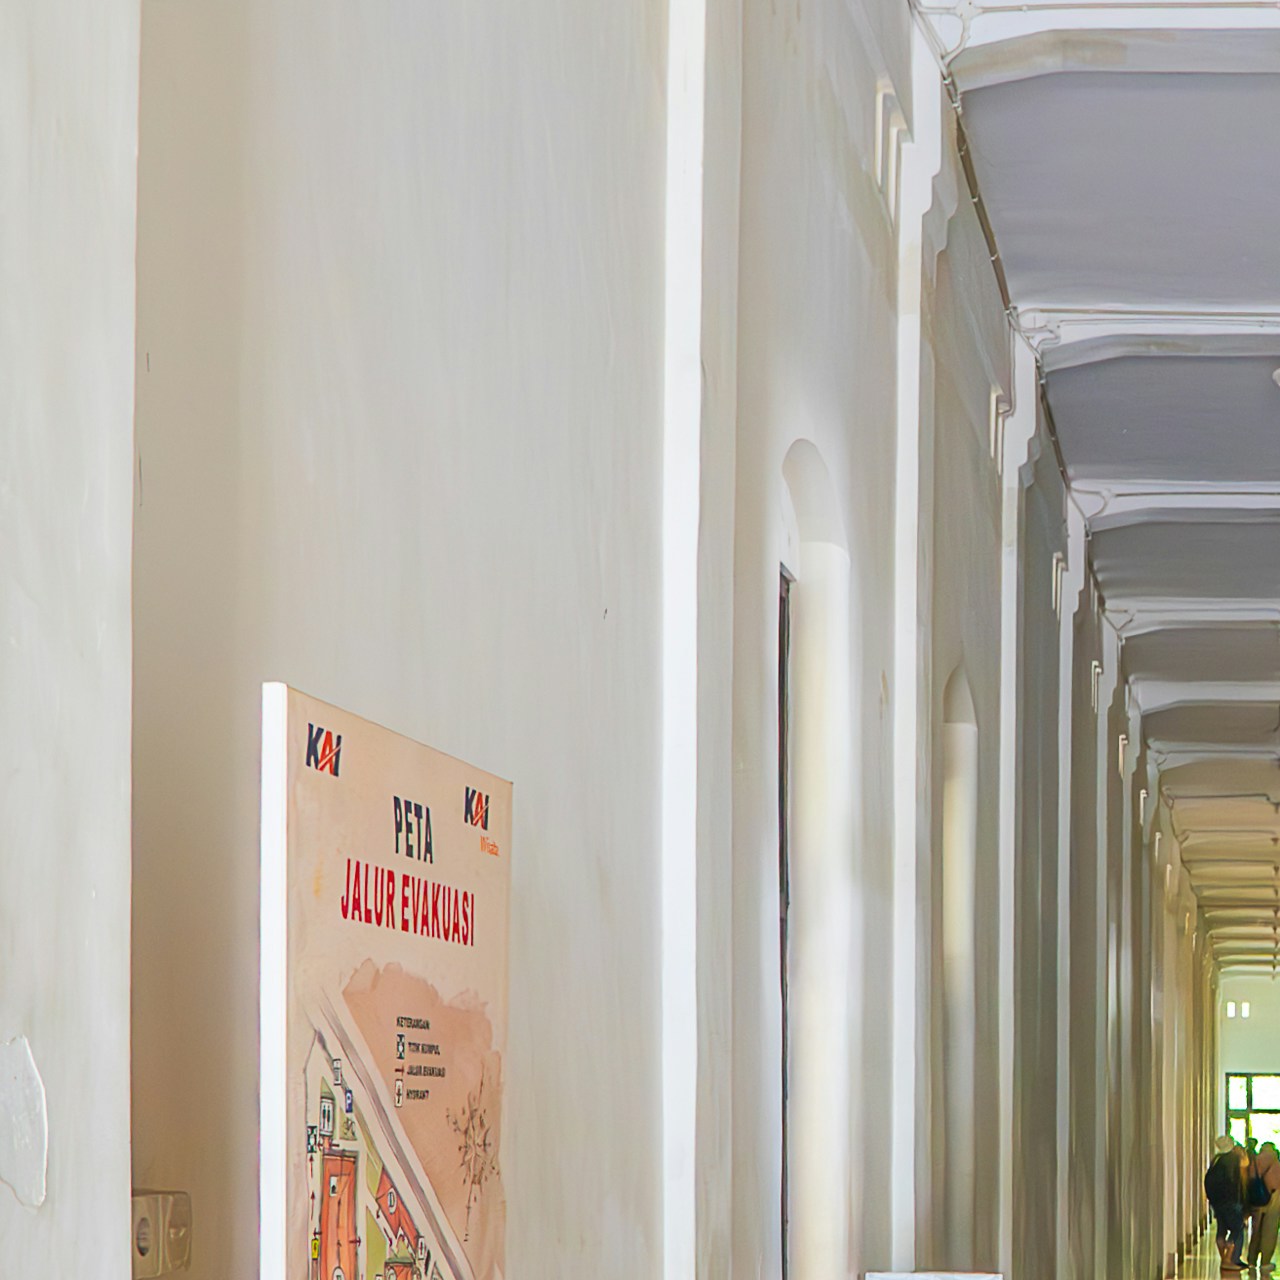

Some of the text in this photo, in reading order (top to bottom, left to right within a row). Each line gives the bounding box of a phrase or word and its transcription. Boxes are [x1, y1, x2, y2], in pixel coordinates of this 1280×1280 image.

[306, 722, 342, 778] KAI
[393, 795, 434, 865] PETA
[464, 786, 490, 831] KAI
[340, 858, 476, 947] JALUR EVAKUASI
